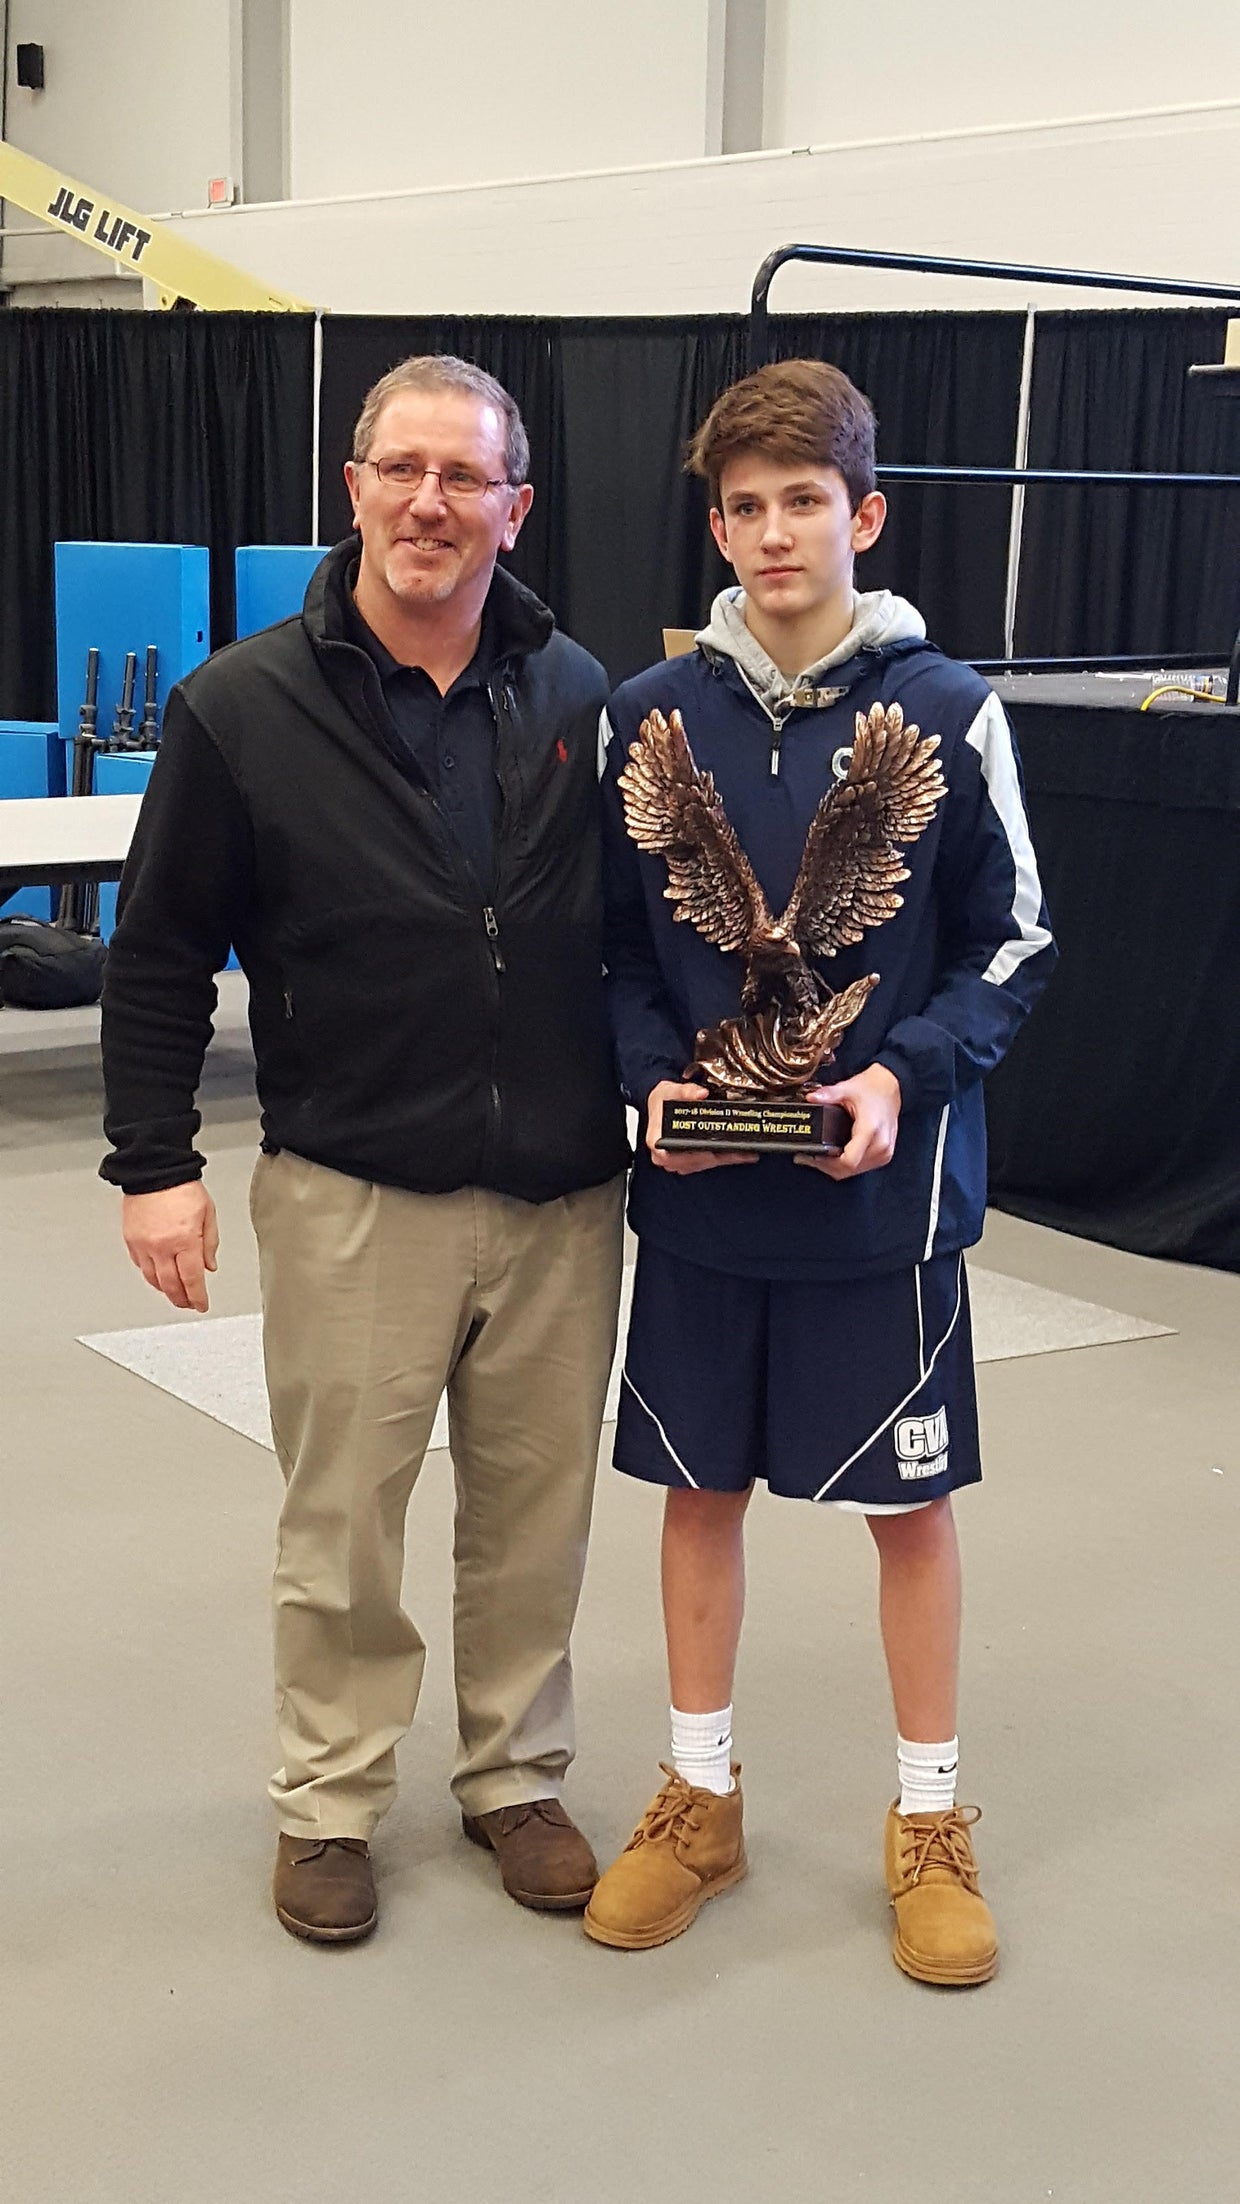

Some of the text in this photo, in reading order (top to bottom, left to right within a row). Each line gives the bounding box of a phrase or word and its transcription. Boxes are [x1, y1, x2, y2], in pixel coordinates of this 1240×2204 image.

[48, 187, 152, 261] JLG LIFT
[700, 1108, 724, 1116] Division
[732, 1109, 762, 1118] Wrestling
[763, 1110, 811, 1119] Championships
[672, 1120, 812, 1134] MOST OUTSTANDING WRESTLER
